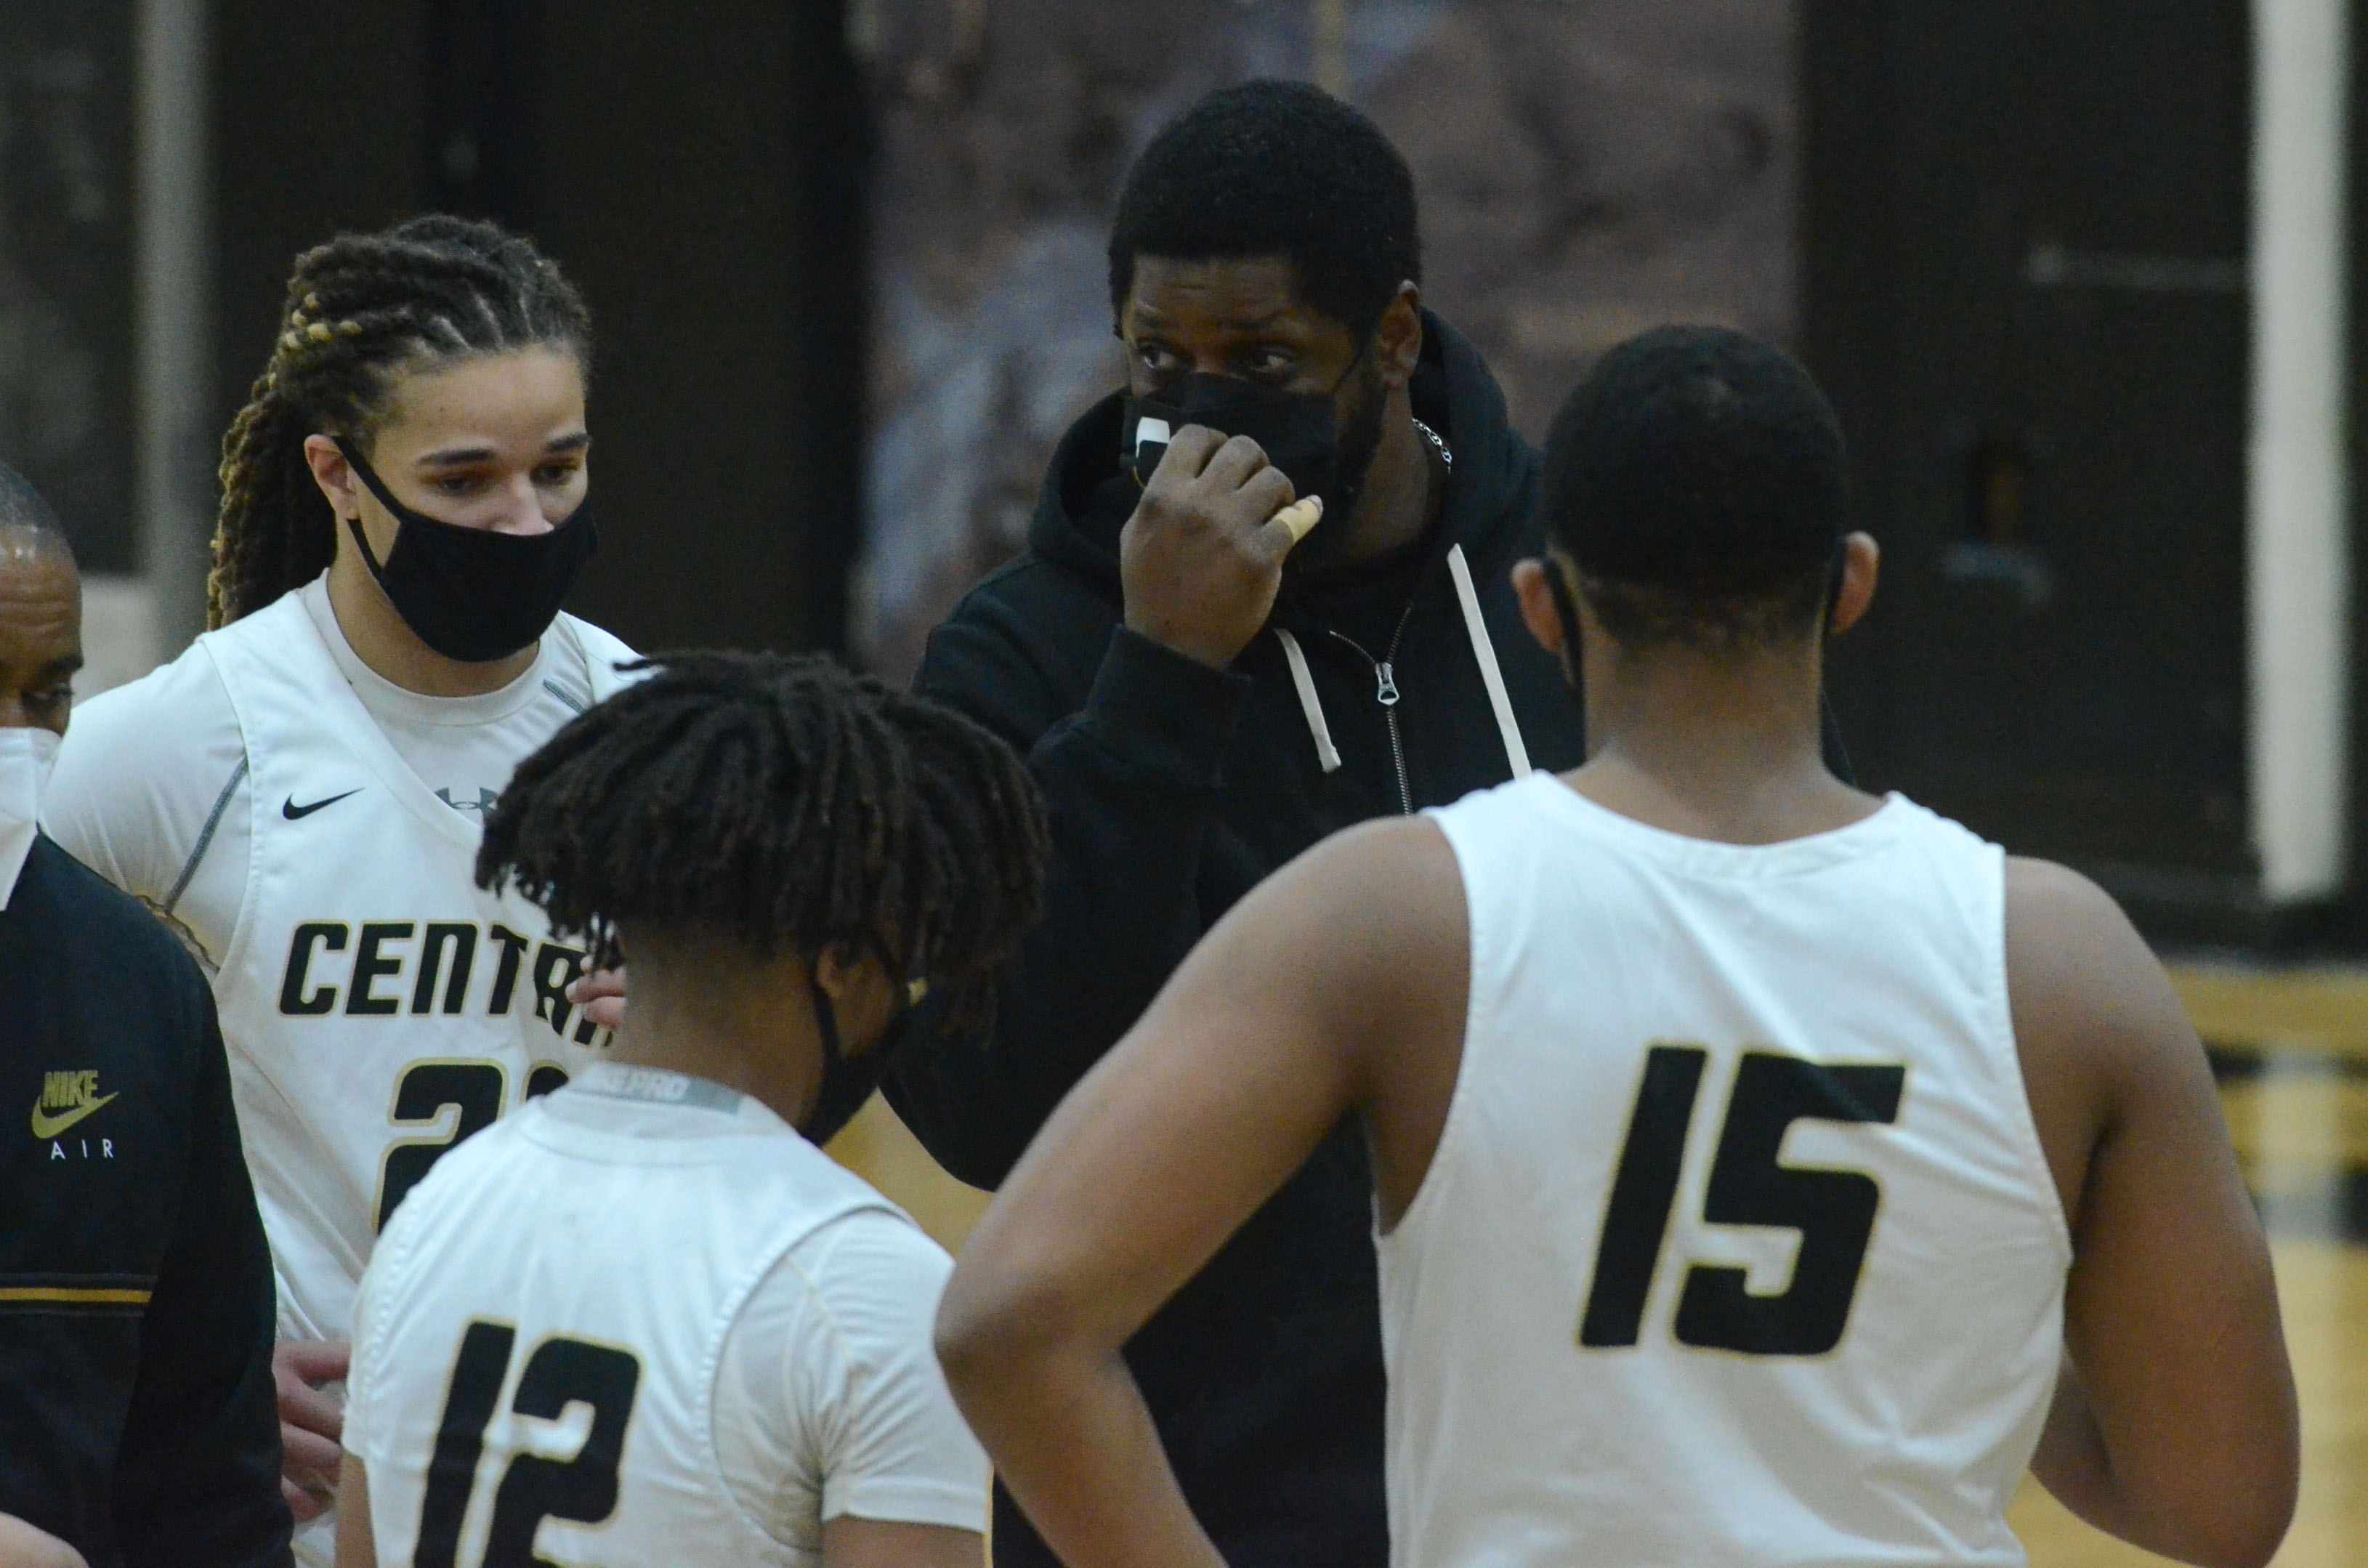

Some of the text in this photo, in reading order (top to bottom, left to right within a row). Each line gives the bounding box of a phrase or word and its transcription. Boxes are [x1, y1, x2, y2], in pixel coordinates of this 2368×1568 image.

[278, 918, 615, 1048] CENTR
[41, 1070, 99, 1107] NIKE
[50, 1138, 114, 1160] AIR
[372, 1057, 570, 1237] 2
[1575, 1040, 1911, 1359] 15
[409, 1314, 647, 1568] 12
